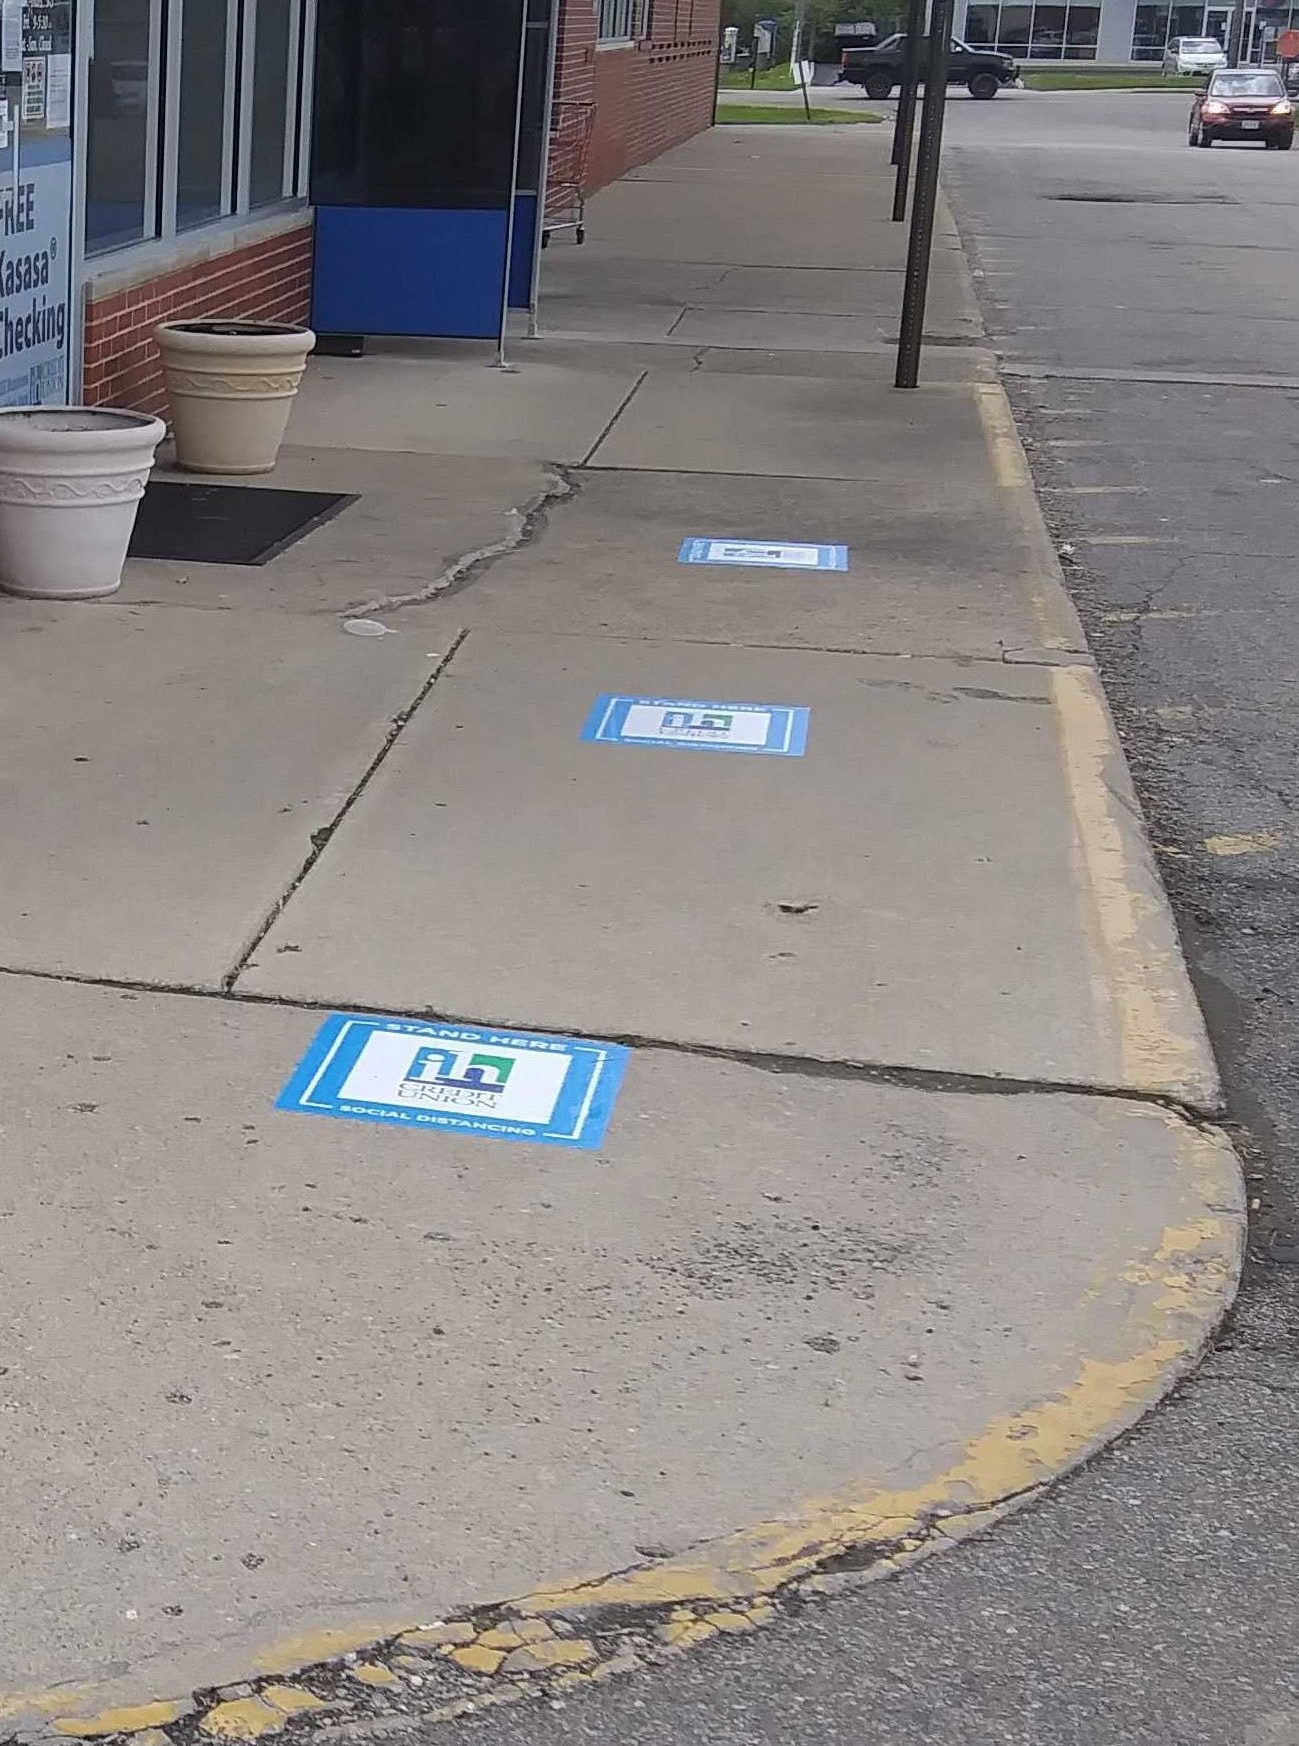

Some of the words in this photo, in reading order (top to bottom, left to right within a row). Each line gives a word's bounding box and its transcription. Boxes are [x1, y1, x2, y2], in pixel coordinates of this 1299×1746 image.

[386, 1023, 481, 1041] STAND
[489, 1034, 568, 1051] HERE
[397, 1089, 498, 1109] UNION
[399, 1083, 499, 1101] CREDIT
[339, 1104, 412, 1121] SOCIAL
[415, 1113, 537, 1137] DISTANCING
